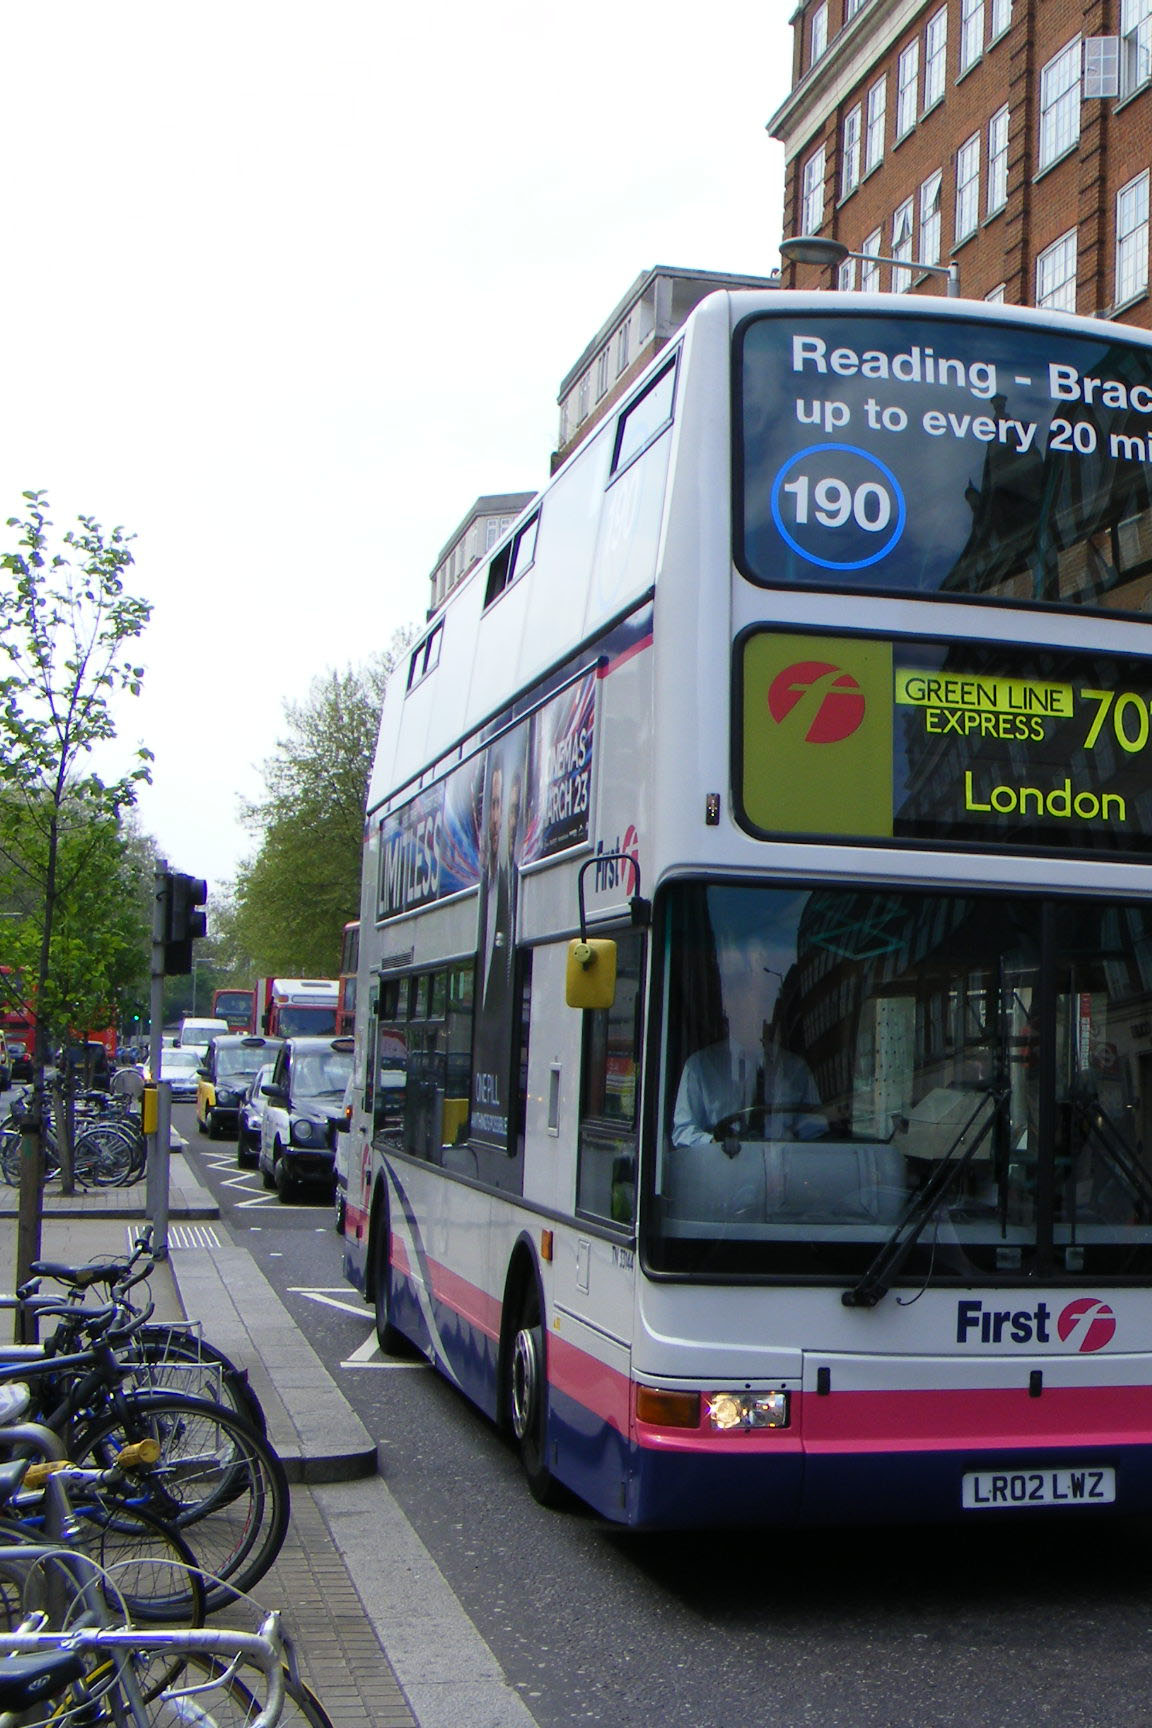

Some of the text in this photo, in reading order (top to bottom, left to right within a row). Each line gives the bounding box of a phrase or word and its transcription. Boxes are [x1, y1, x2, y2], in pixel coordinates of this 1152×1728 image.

[792, 335, 998, 398] Reading
[796, 398, 851, 431] up
[865, 397, 908, 431] to
[923, 409, 1037, 452] every
[1050, 418, 1097, 453] 20
[782, 475, 891, 532] 190
[905, 678, 1063, 713] GREEN LINE
[926, 709, 1045, 741] EXPRESS
[573, 772, 588, 814] 23
[964, 770, 1126, 821] London
[957, 1300, 1050, 1343] First
[973, 1471, 1104, 1502] LR02 LWZ
